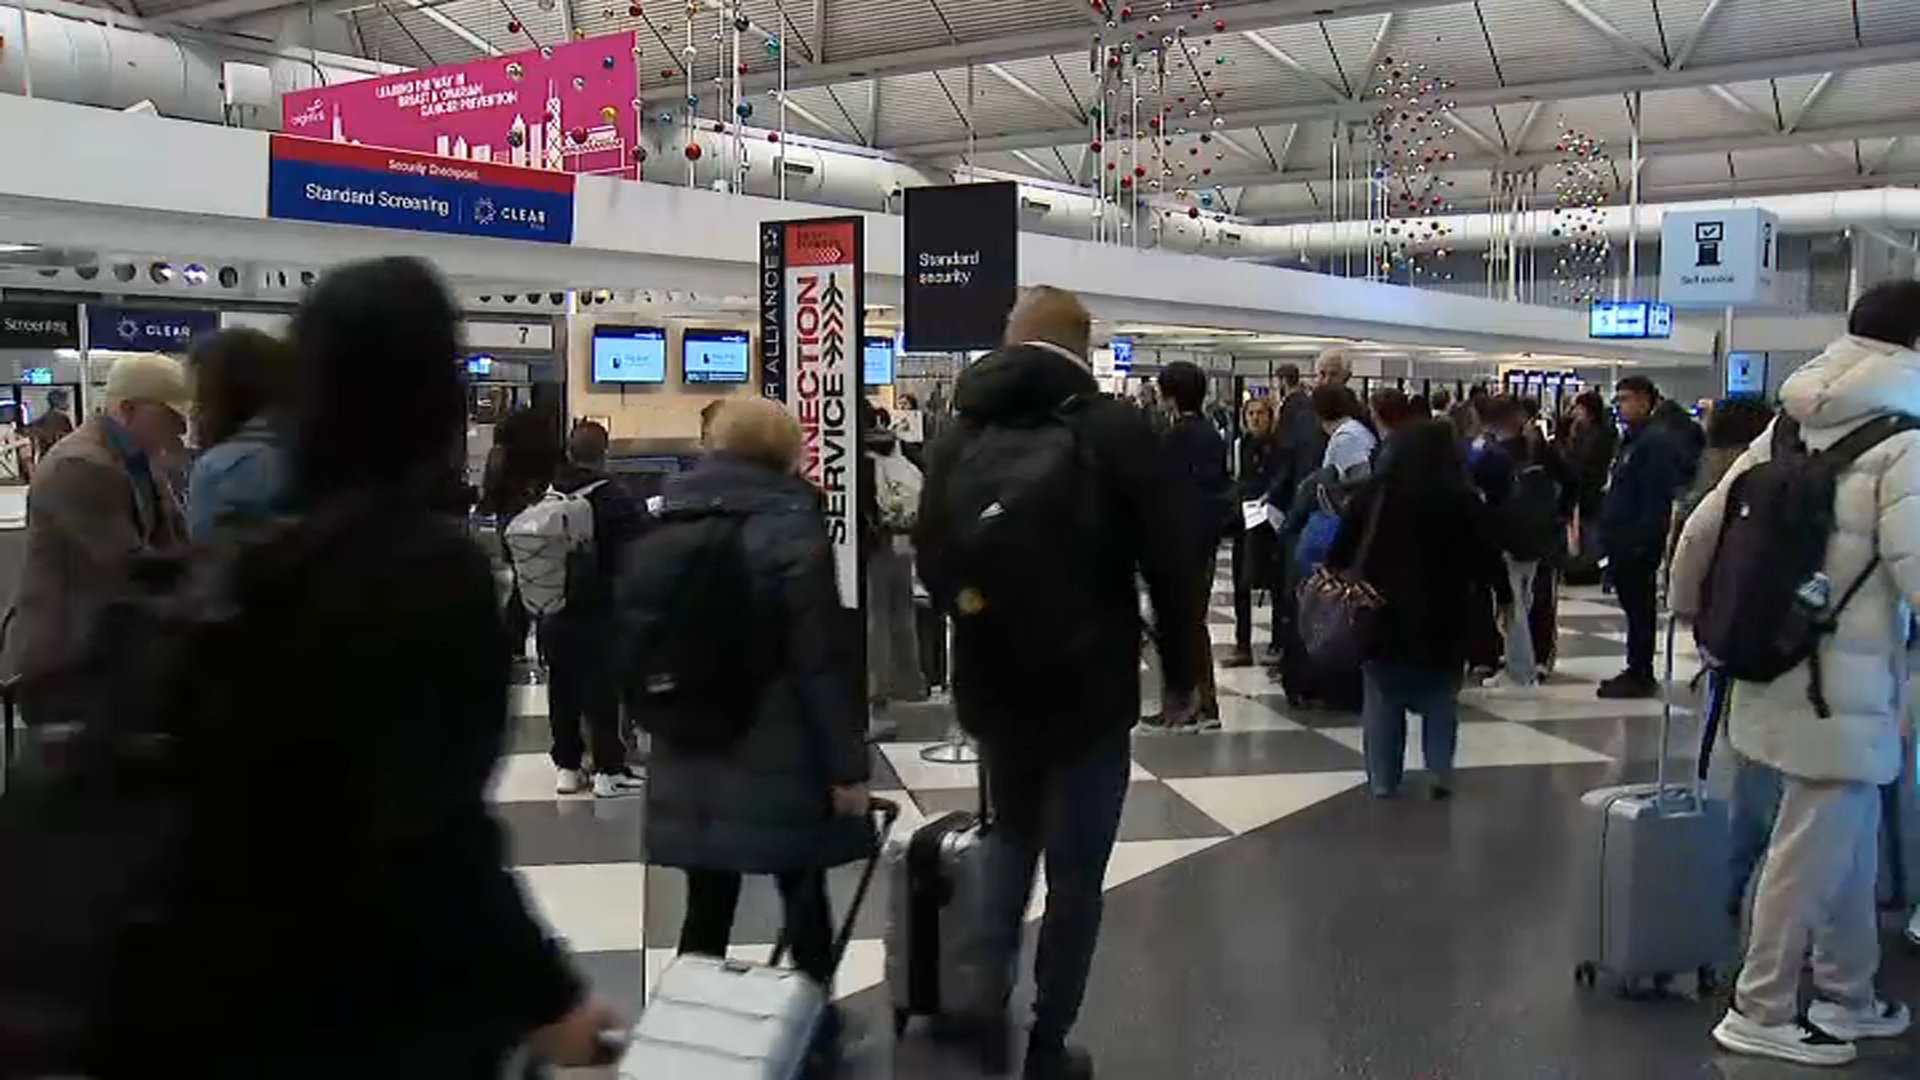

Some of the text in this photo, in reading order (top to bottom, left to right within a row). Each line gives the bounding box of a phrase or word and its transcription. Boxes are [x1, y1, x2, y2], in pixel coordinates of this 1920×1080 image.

[388, 158, 480, 181] Security Checkpoint
[306, 183, 449, 217] Standard Screening
[501, 207, 546, 223] CLEAR
[919, 250, 980, 267] Standard
[919, 269, 972, 288] security
[764, 255, 779, 375] ALLIANCE
[4, 318, 69, 336] Screening
[146, 324, 191, 337] CLEAR
[519, 327, 529, 344] 7
[797, 276, 821, 483] NNECTION
[823, 373, 846, 544] SERVICE
